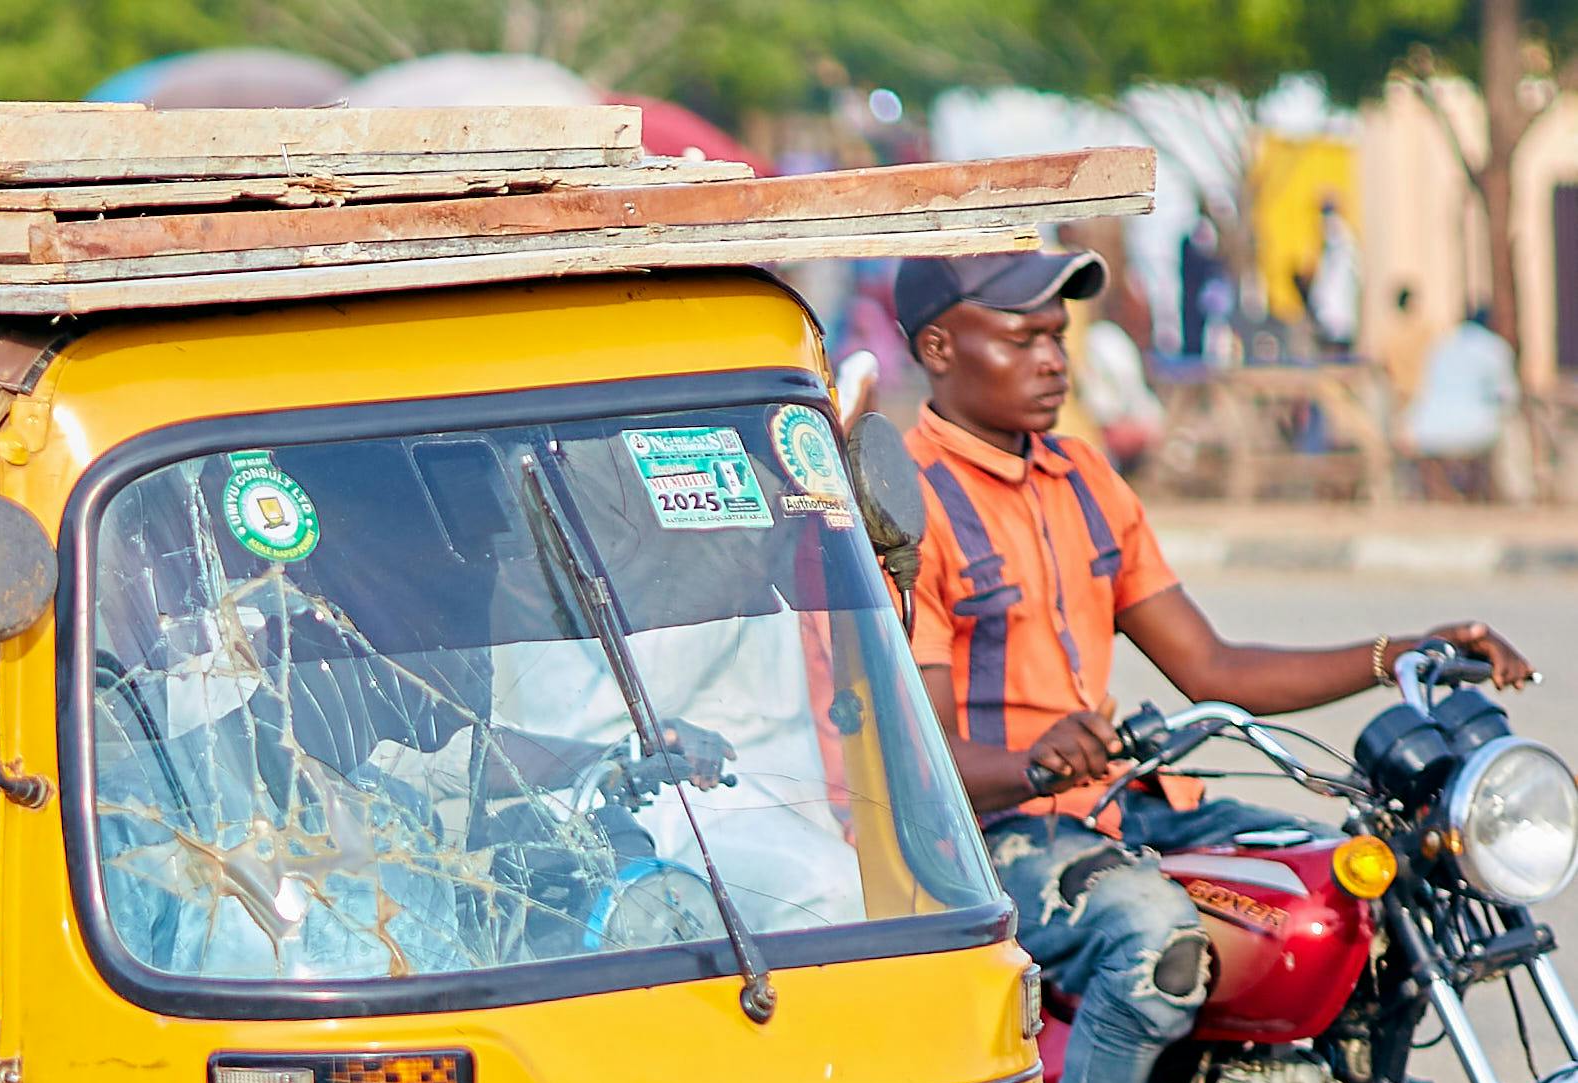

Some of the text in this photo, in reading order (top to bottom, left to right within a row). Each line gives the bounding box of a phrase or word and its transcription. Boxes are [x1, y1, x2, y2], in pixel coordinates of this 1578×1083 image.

[235, 467, 294, 488] CONSULT
[291, 485, 313, 514] LTD
[658, 492, 722, 512] 2025
[786, 497, 840, 511] Authorized
